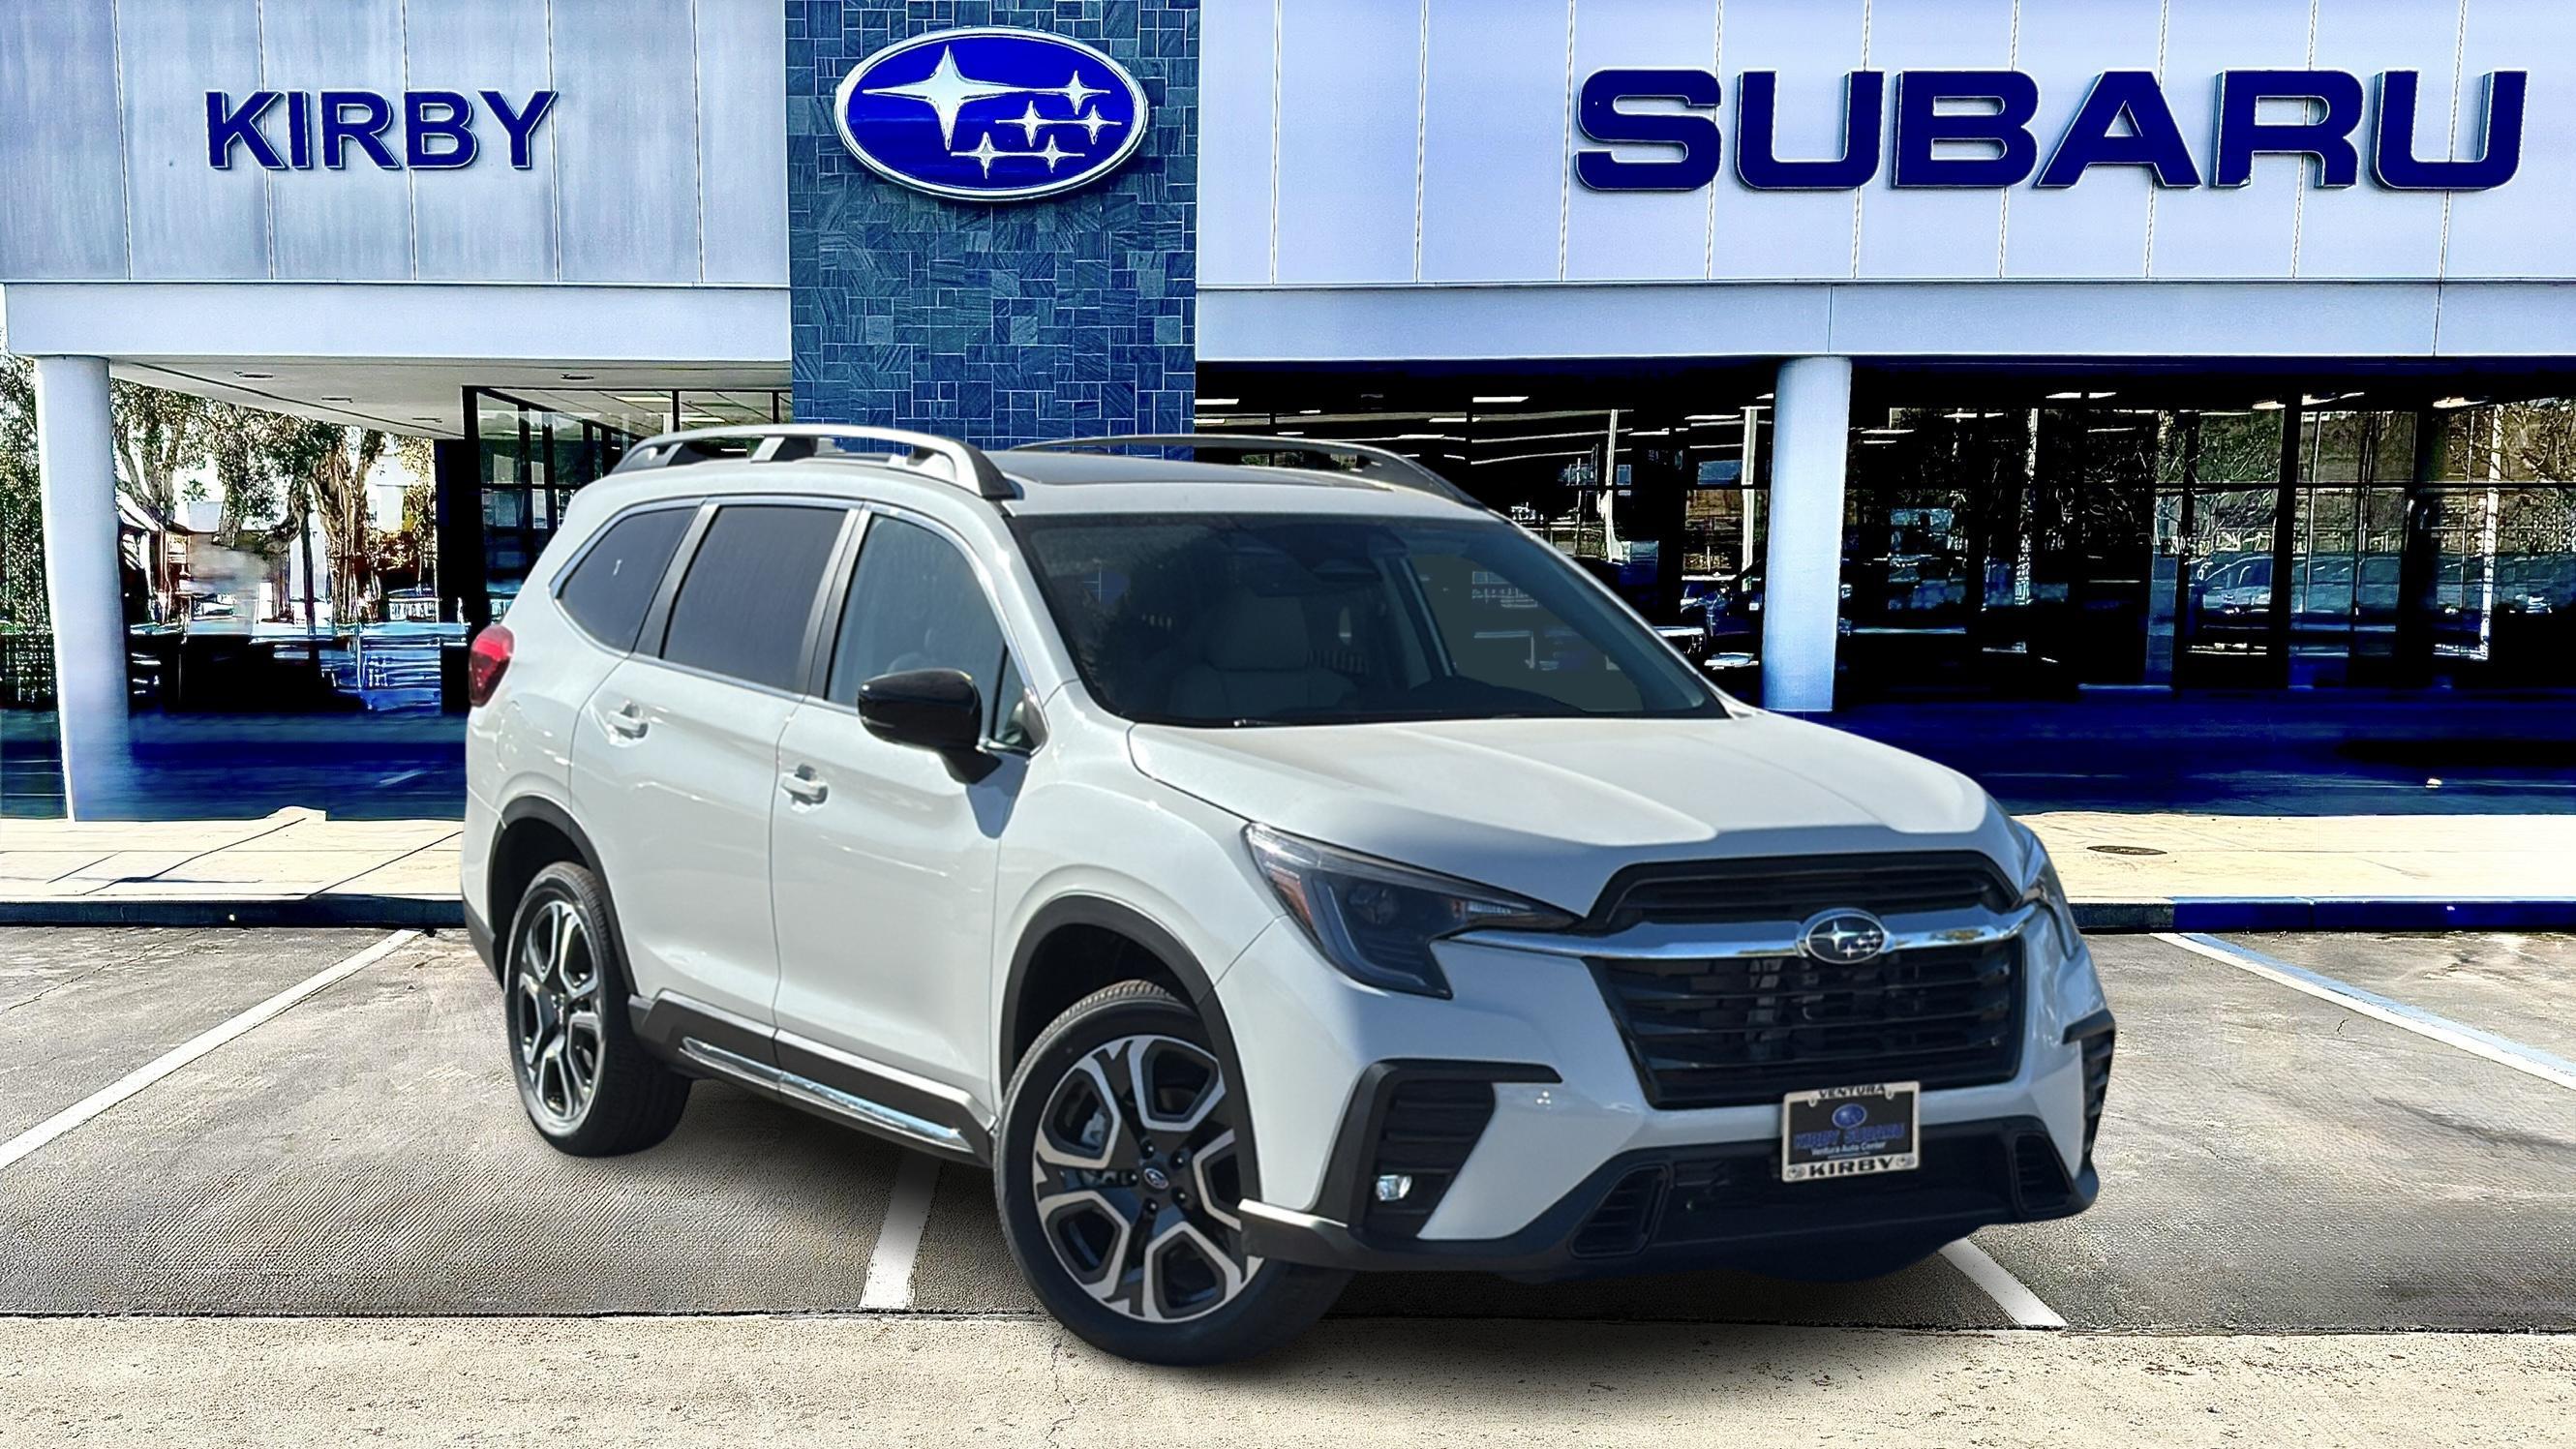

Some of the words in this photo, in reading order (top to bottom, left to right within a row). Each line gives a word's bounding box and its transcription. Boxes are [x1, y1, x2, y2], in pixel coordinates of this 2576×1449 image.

[204, 89, 560, 170] KIRBY
[1575, 69, 2528, 191] SUBARU
[1819, 1085, 1886, 1099] VENTURA
[1794, 1130, 1839, 1149] KIRBY
[1811, 1146, 1839, 1156] Ventura
[1841, 1143, 1860, 1153] Auto
[1861, 1141, 1886, 1151] Center
[1809, 1157, 1894, 1177] KIRBY
